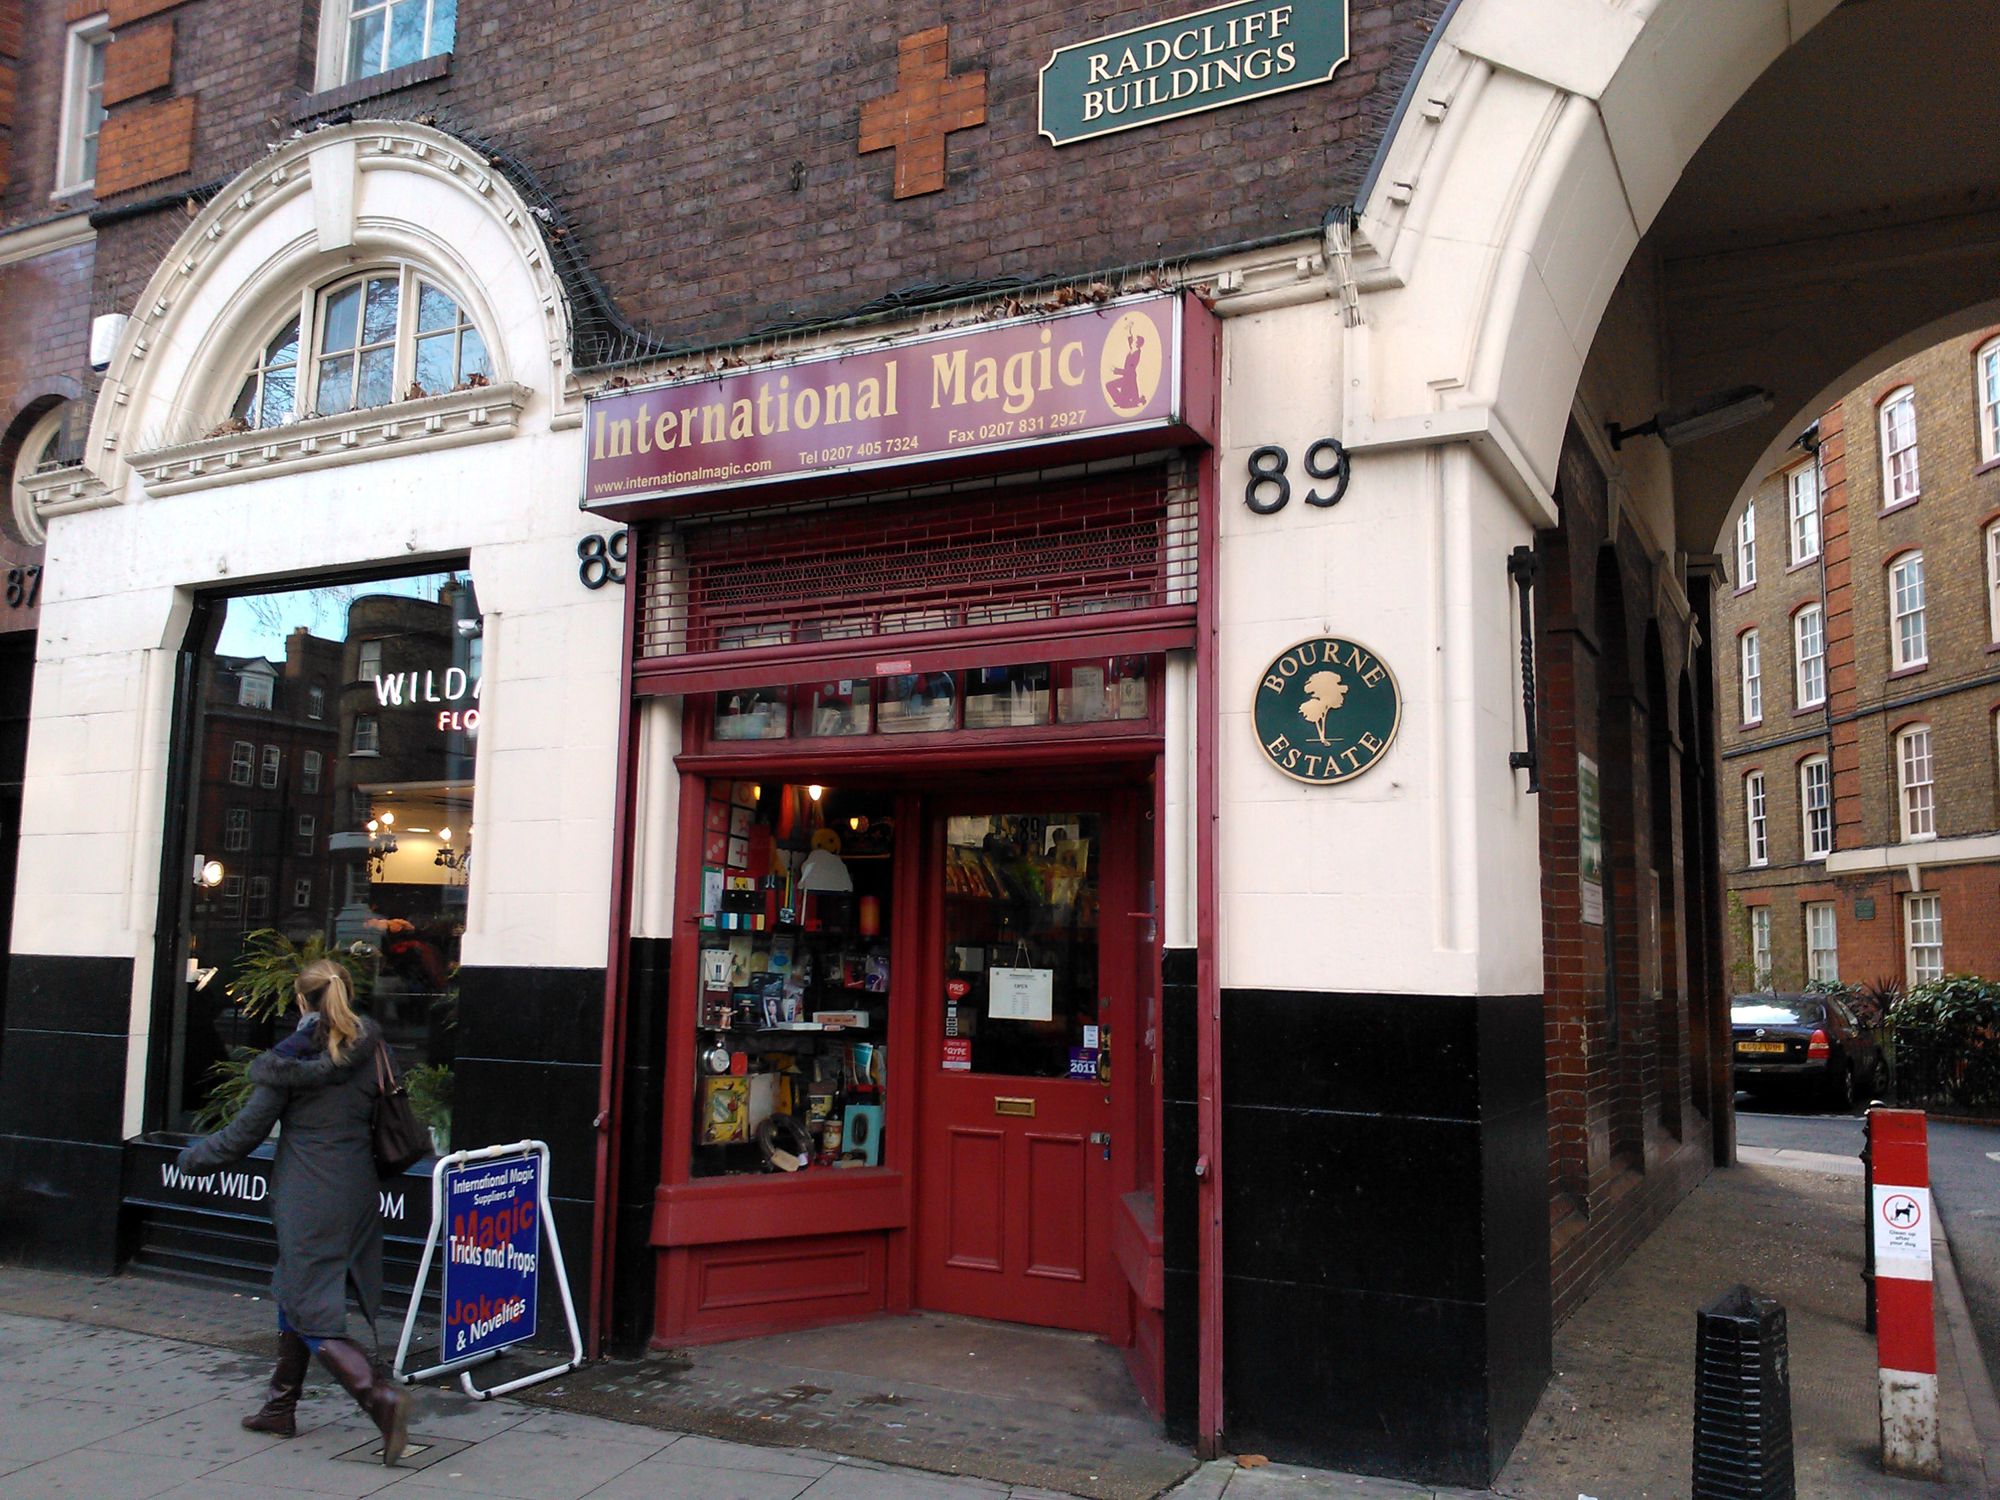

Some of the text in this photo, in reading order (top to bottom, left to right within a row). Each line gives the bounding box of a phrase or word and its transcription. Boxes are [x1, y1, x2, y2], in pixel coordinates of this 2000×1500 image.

[1087, 5, 1294, 85] RADCLIFF
[1081, 41, 1297, 122] BUILDINGS
[592, 328, 1086, 460] International Magic
[799, 410, 1087, 465] Tel 0207 405 7324 Fax 0207 831 2927
[594, 460, 772, 493] www.internationalmagic.com
[1245, 437, 1350, 515] 89
[6, 565, 44, 609] 87
[577, 530, 629, 590] 89
[1264, 641, 1386, 695] BOURNE
[1266, 731, 1383, 778] ESTATE
[1070, 1062, 1097, 1074] 2011
[453, 1165, 534, 1194] International Magic
[473, 1186, 517, 1206] Suppliers of
[450, 1235, 536, 1278] Tricks and Props
[455, 1197, 534, 1264] Magic
[456, 1298, 526, 1352] & Novelties
